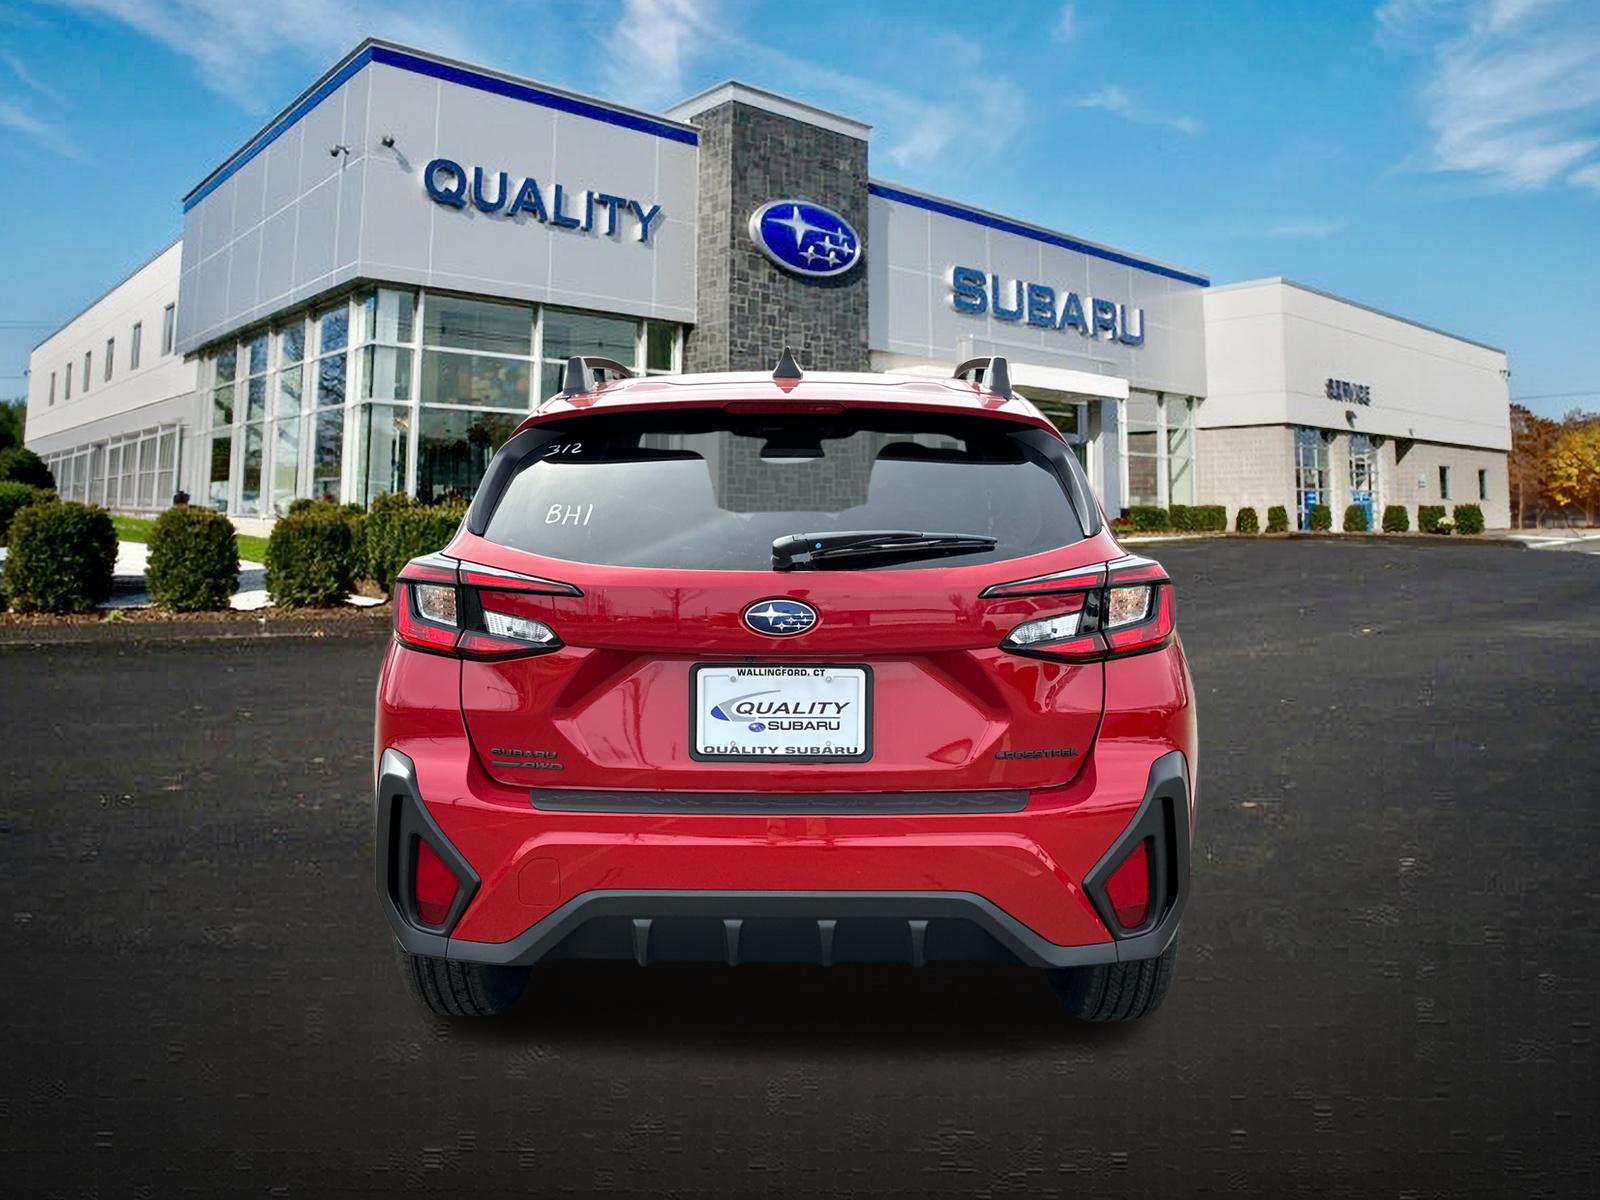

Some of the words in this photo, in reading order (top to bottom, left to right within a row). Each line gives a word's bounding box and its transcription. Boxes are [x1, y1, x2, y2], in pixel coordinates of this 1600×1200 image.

[424, 158, 661, 243] QUALITY
[950, 265, 1145, 346] SUBARU
[543, 442, 582, 457] 312
[813, 669, 826, 677] CT
[735, 702, 850, 715] QUALITY
[767, 721, 840, 731] SUBARU
[490, 747, 558, 759] SUBARU
[703, 745, 779, 754] QUALITY
[785, 746, 858, 754] SUBARU
